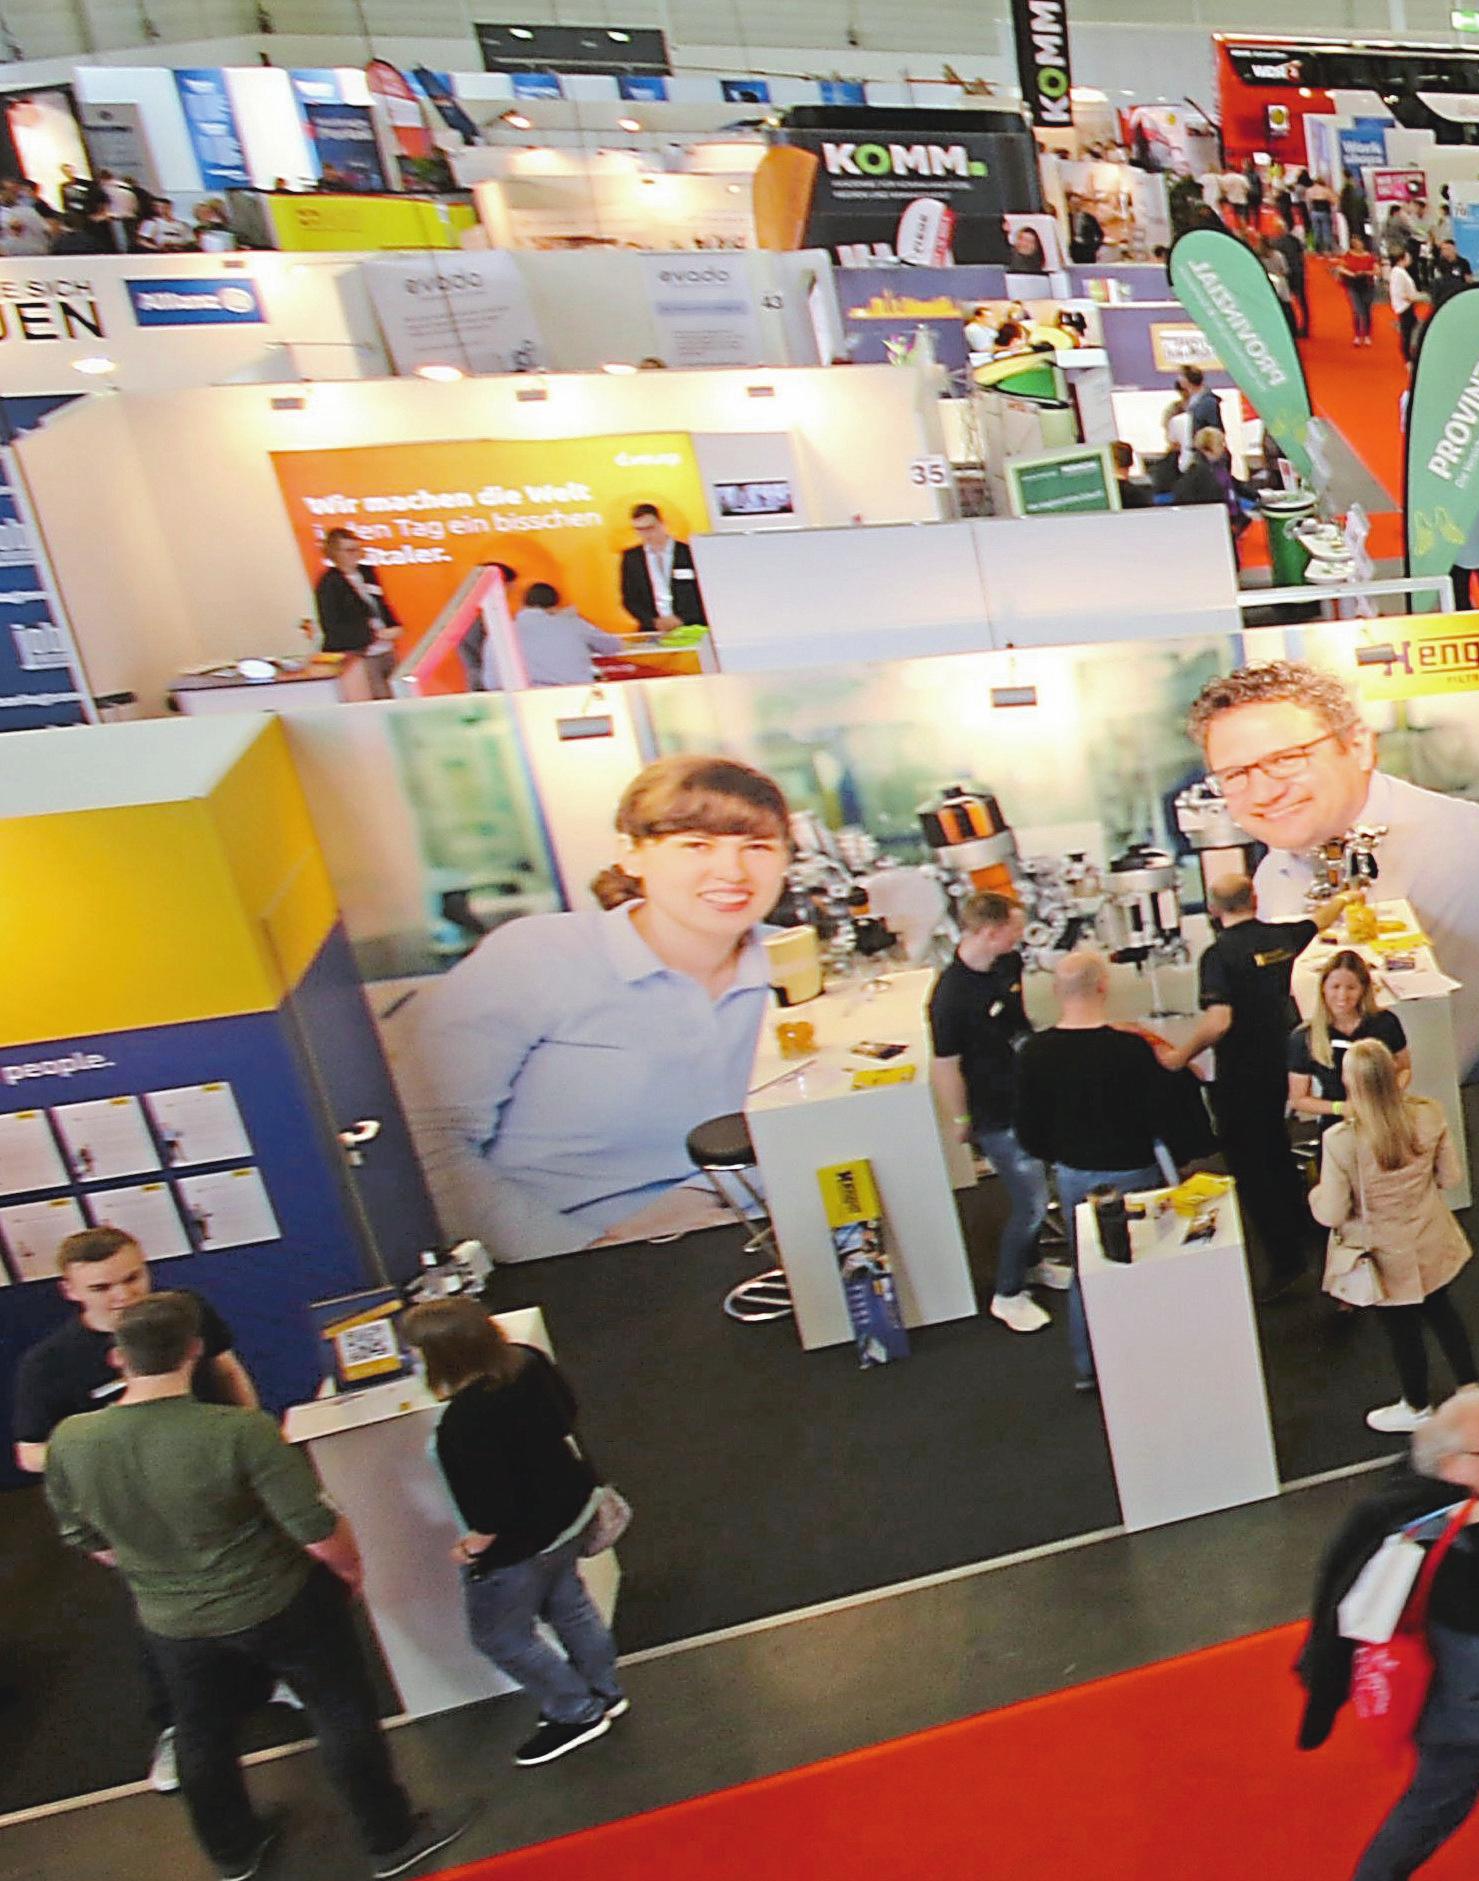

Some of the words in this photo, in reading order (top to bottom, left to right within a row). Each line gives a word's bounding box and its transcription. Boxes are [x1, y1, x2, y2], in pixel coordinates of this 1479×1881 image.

[910, 463, 945, 485] 35
[303, 494, 360, 516] Wir
[364, 489, 475, 514] machen
[477, 484, 524, 507] die
[524, 481, 593, 504] Welt
[394, 517, 447, 541] Tag
[448, 514, 488, 536] ein
[495, 509, 602, 533] bisschen
